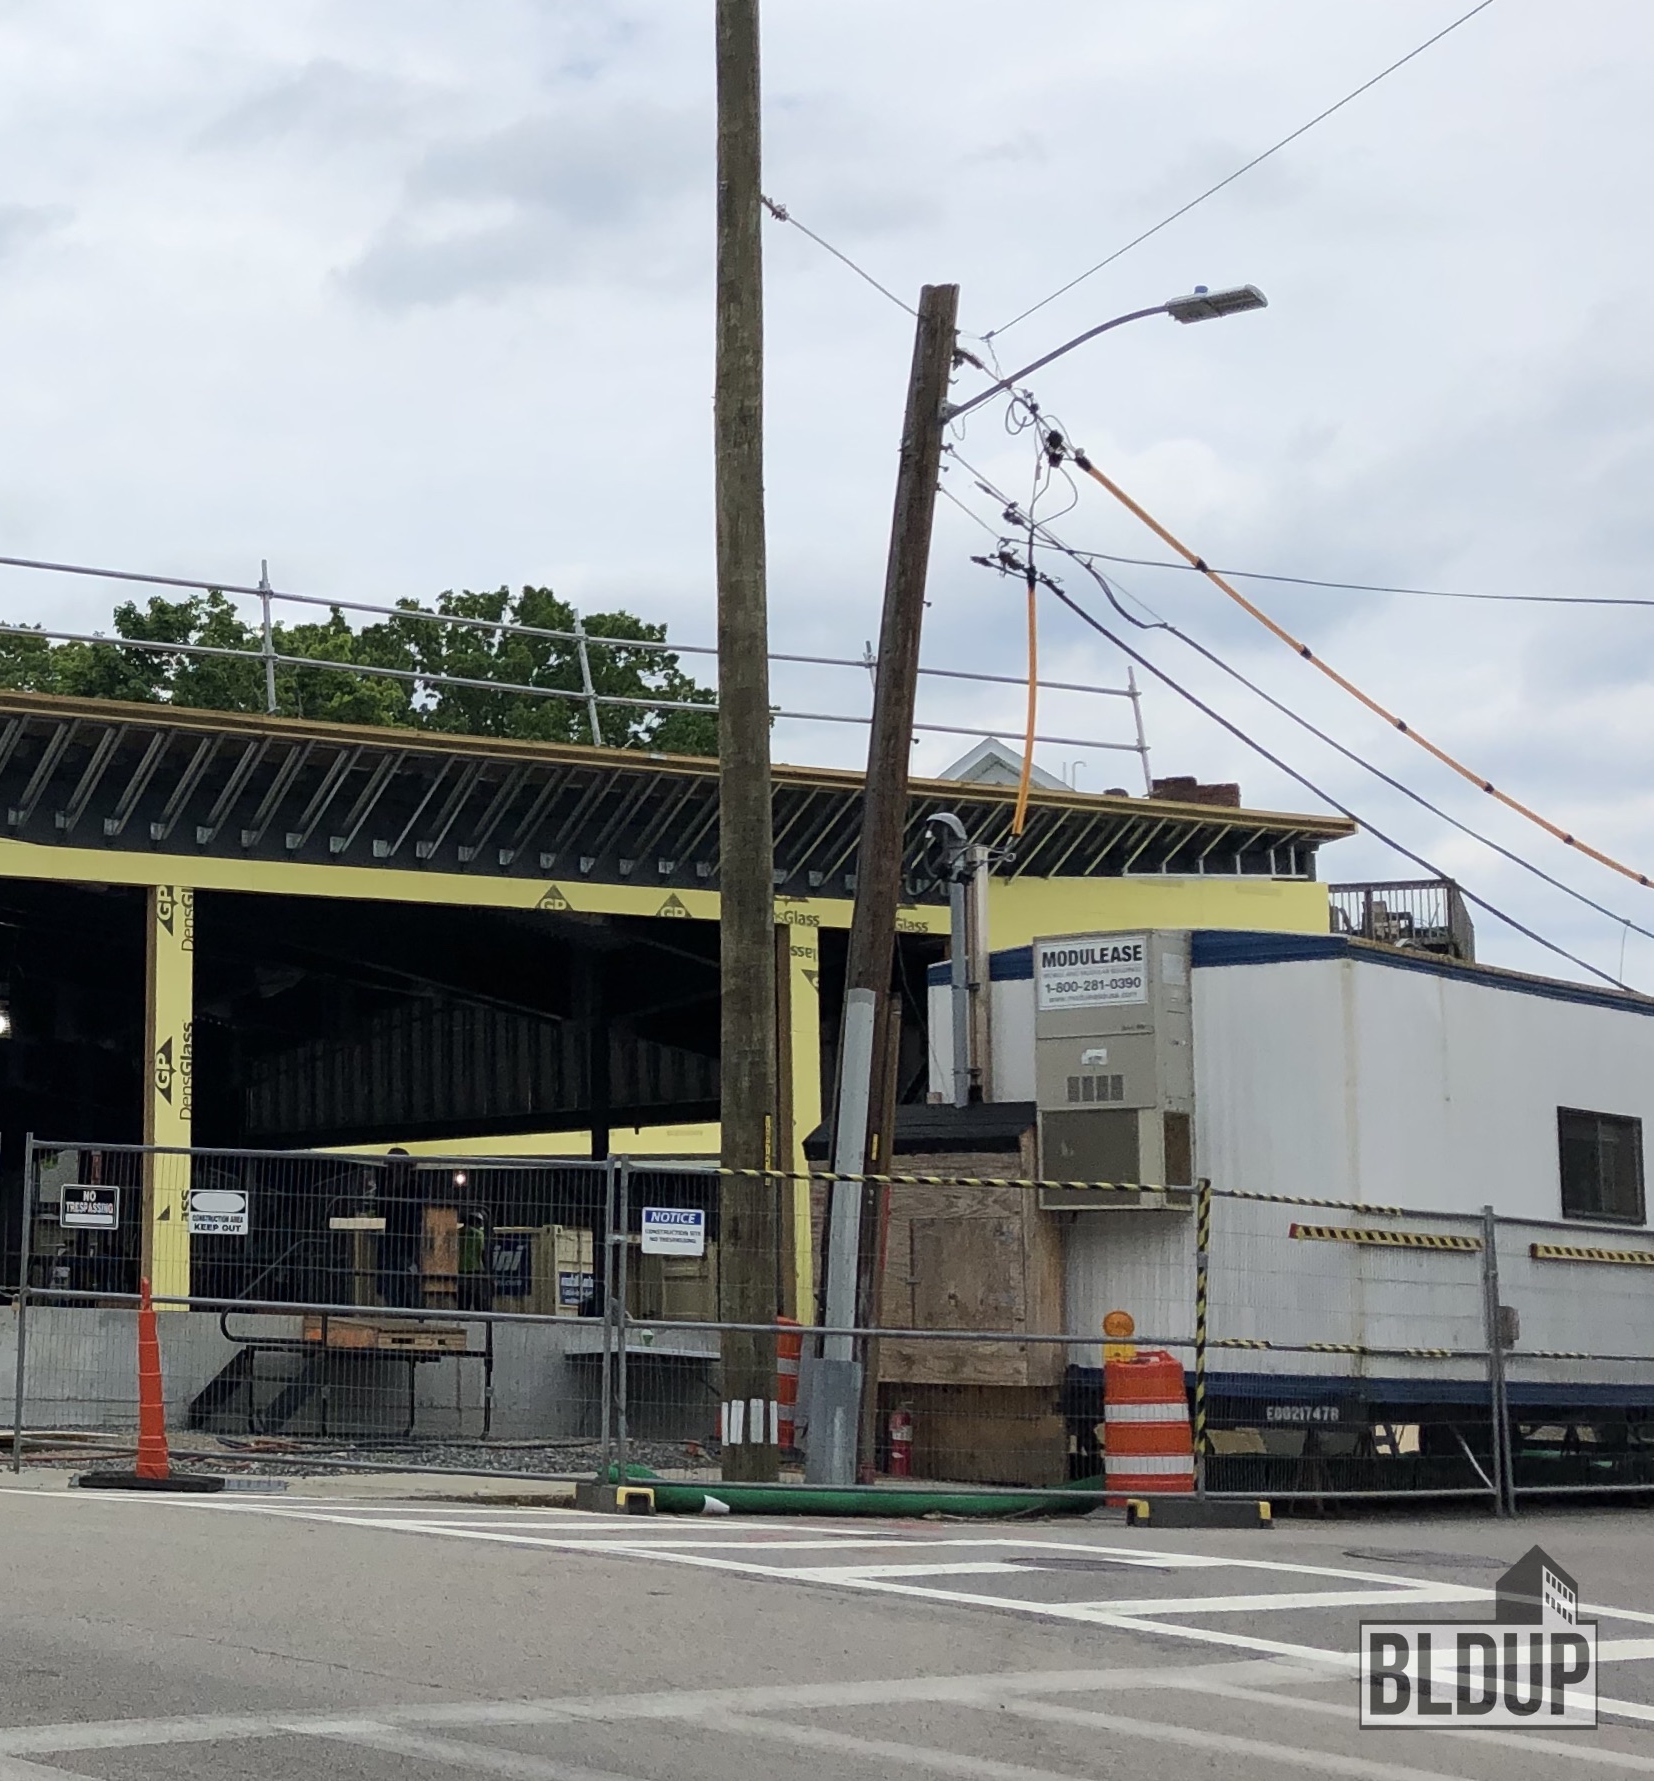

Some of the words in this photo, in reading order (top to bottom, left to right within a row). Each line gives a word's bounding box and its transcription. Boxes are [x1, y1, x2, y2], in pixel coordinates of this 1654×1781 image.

[157, 884, 172, 920] GP
[1042, 944, 1143, 968] MODULEASE
[1045, 976, 1142, 994] 1-800-281-0390
[154, 1053, 171, 1090] GP
[180, 1022, 193, 1120] DensGlass
[83, 1190, 96, 1201] NO
[66, 1202, 114, 1214] TRESPASSING
[192, 1214, 229, 1223] CONSTRUCTION
[230, 1215, 244, 1223] AREA
[650, 1211, 697, 1224] NOTICE
[194, 1223, 219, 1231] KEEP
[222, 1224, 242, 1232] OUT
